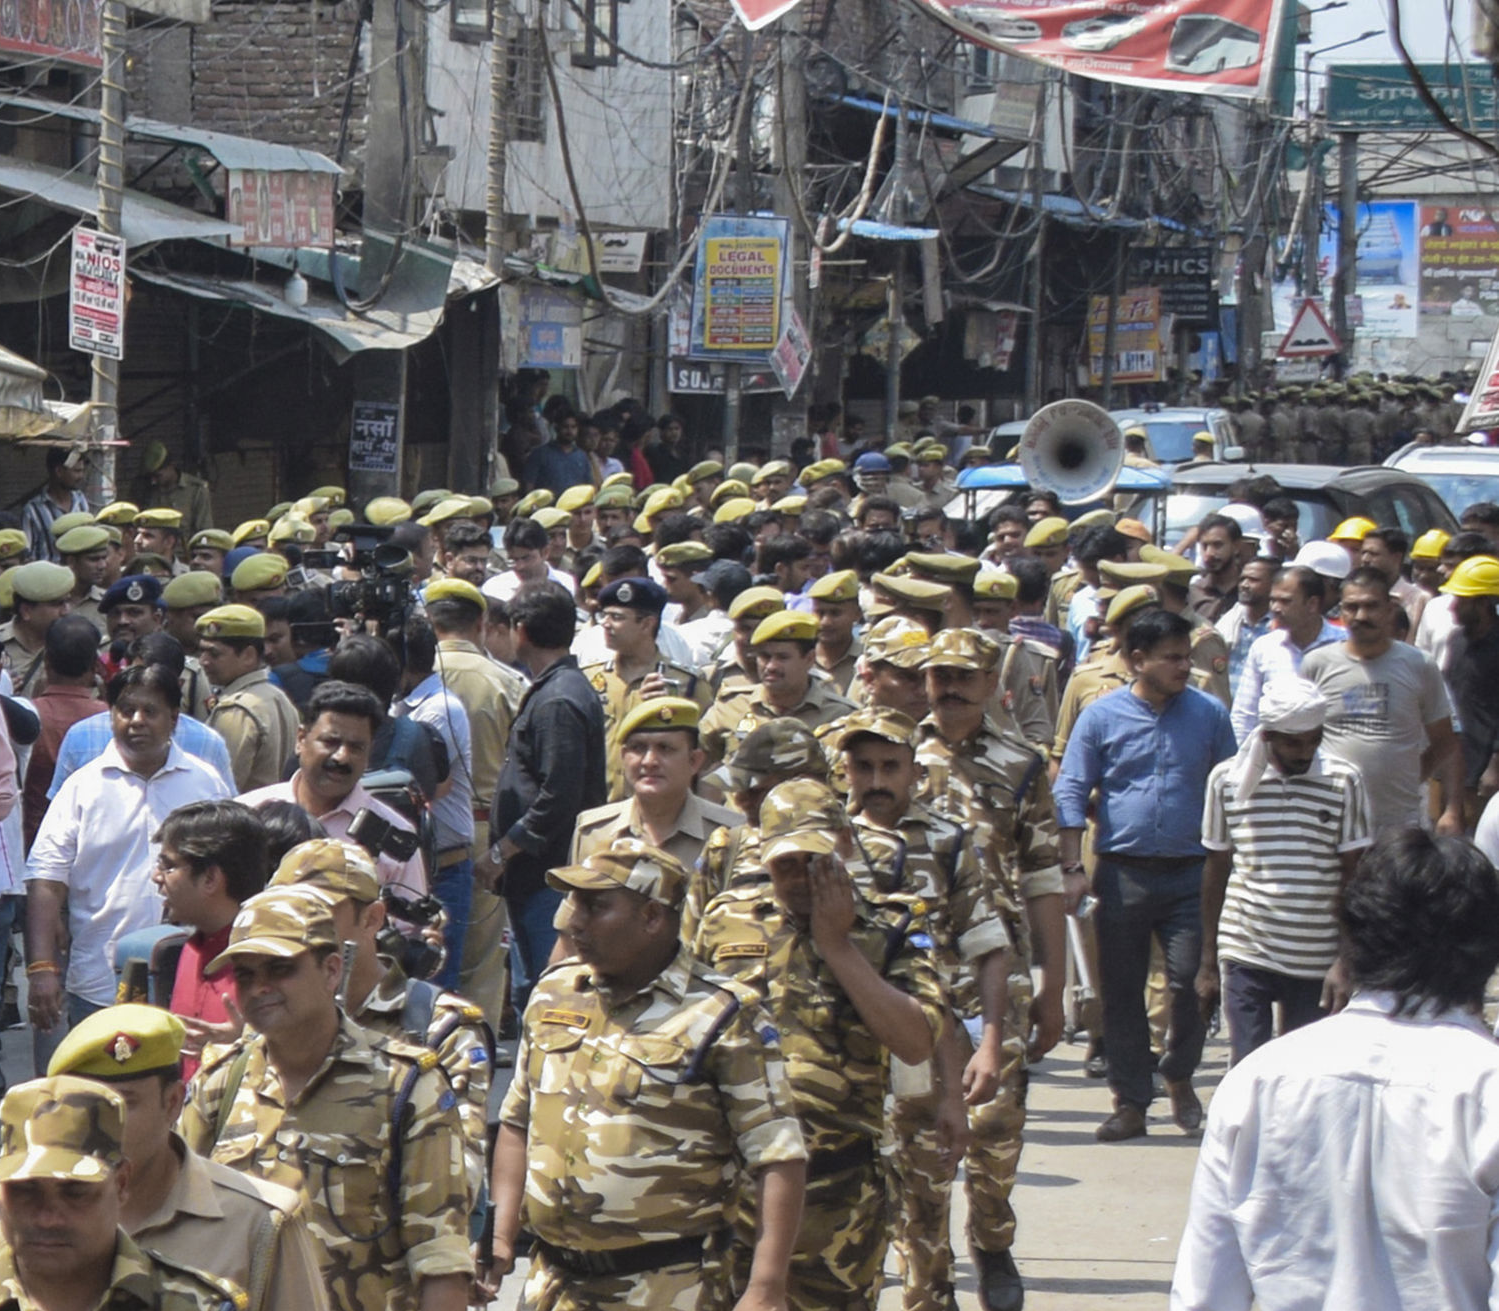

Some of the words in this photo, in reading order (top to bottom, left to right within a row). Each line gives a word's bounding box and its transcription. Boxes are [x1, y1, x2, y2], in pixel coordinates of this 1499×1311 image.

[719, 251, 765, 262] LEGAL
[87, 252, 120, 273] NIOS
[709, 264, 774, 275] DOCUMENTS
